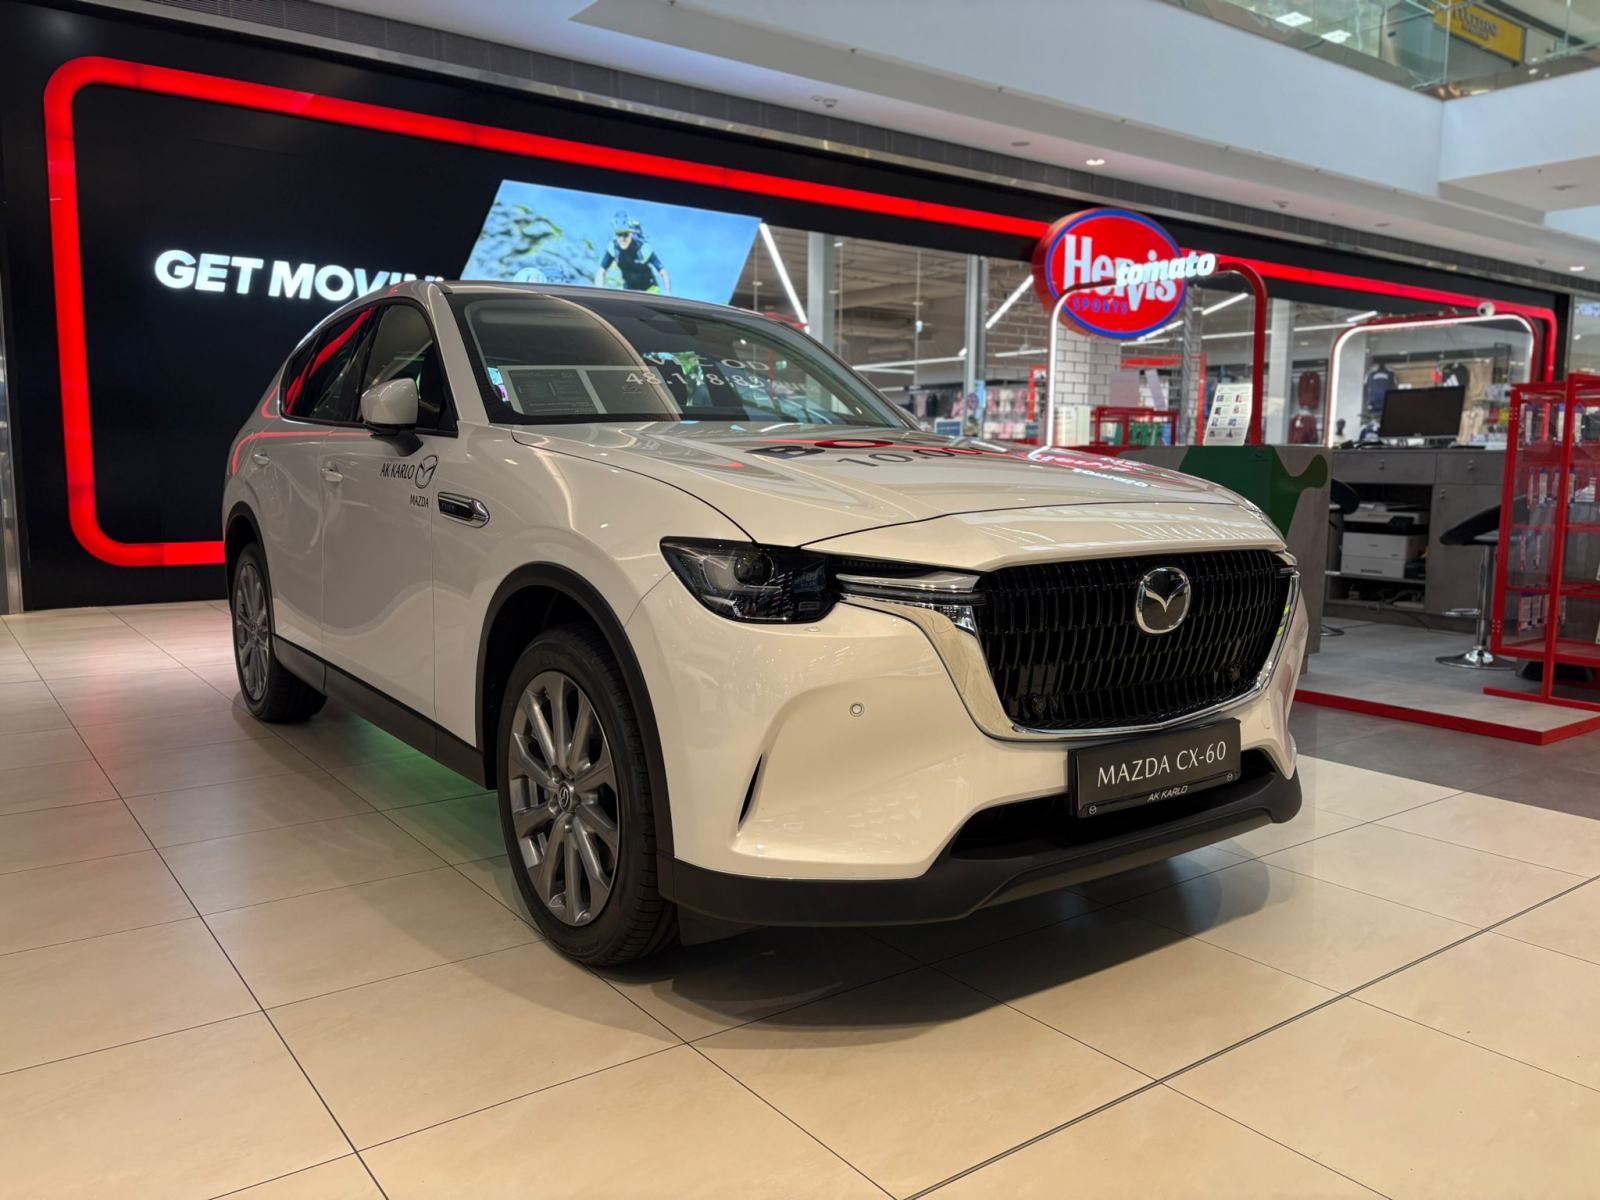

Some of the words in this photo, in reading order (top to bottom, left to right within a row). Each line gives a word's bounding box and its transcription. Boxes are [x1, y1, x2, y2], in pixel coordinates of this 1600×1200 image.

[154, 250, 264, 294] GET
[1116, 251, 1217, 287] tomato
[381, 463, 390, 477] AK
[391, 463, 415, 479] KARLO
[410, 494, 429, 508] MAZDA
[1097, 754, 1171, 788] MAZDA
[1176, 740, 1227, 771] CX-60
[1147, 791, 1160, 802] AK
[1161, 785, 1188, 799] KARLO
